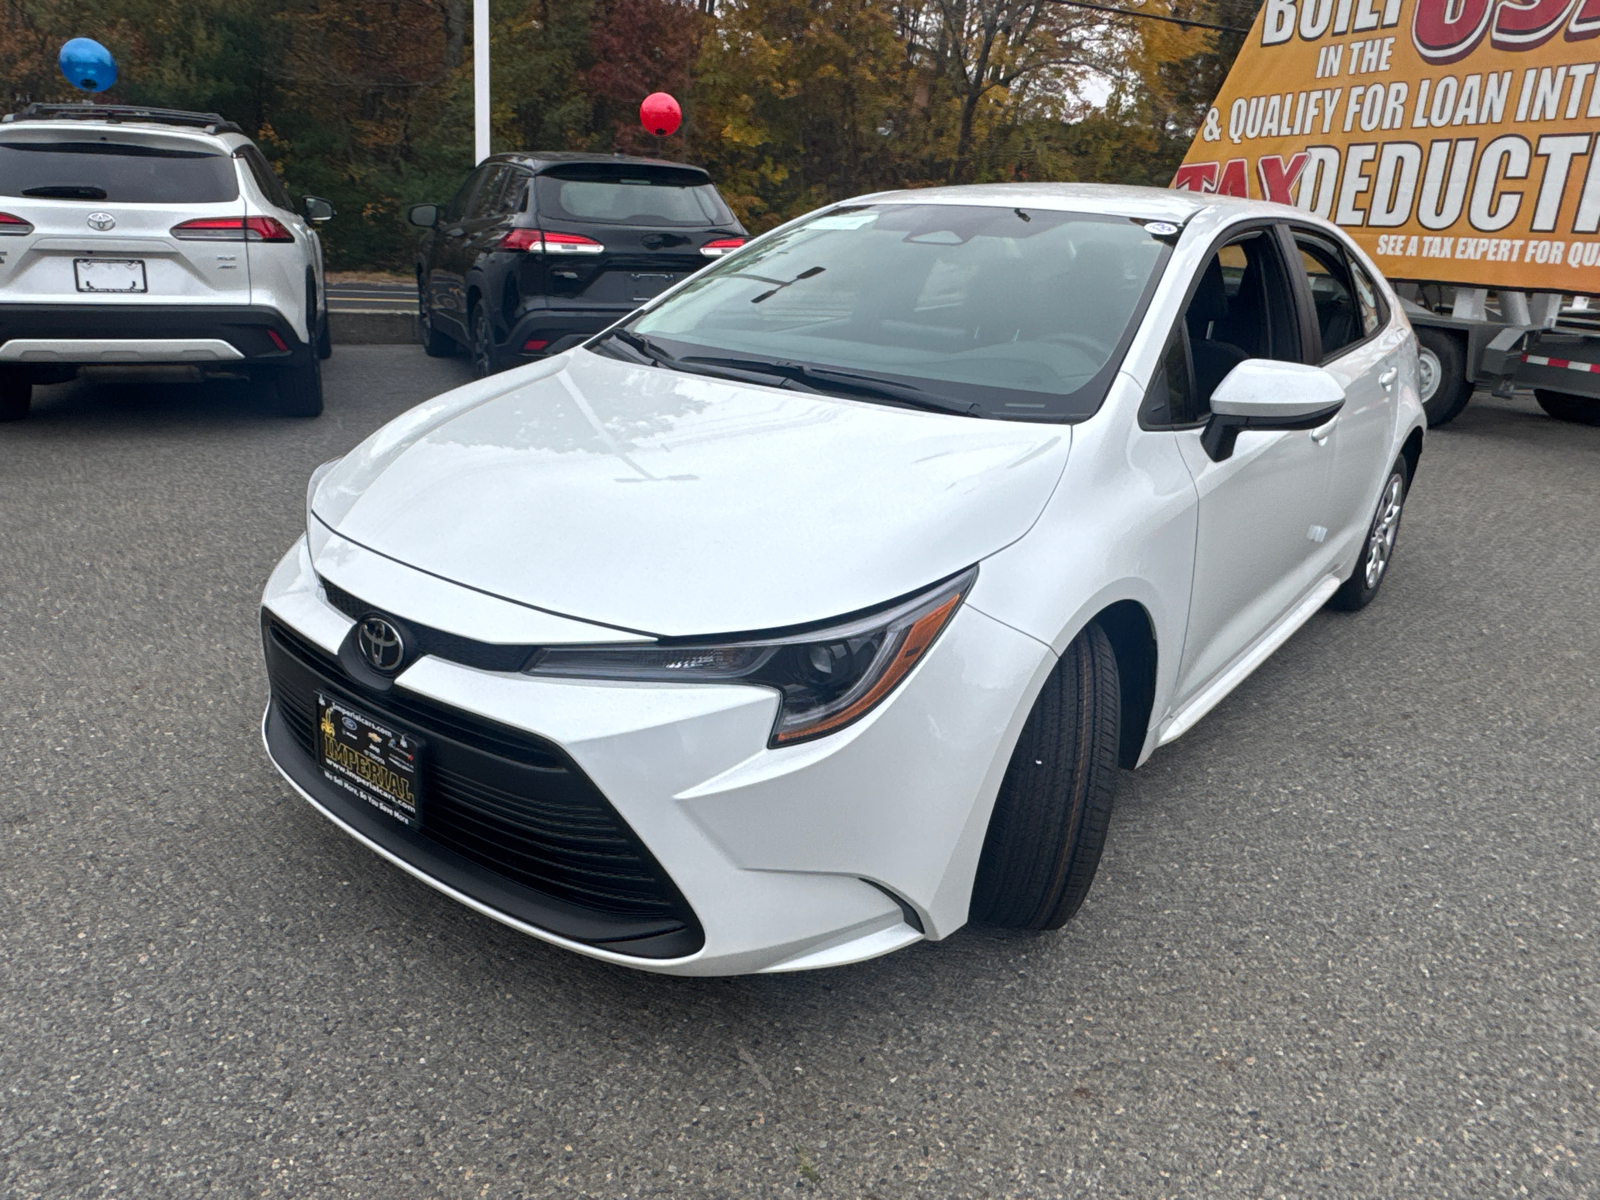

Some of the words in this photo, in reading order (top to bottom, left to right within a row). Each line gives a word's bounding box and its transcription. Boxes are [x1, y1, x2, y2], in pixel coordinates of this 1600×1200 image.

[1315, 44, 1343, 79] IN
[1348, 36, 1395, 75] THE
[1203, 108, 1222, 142] &
[1228, 88, 1342, 144] QUALIFY
[1343, 82, 1409, 133] FOR
[1411, 71, 1513, 128] LOAN
[1176, 152, 1311, 206] TAX
[1376, 234, 1406, 256] SEE
[1405, 235, 1419, 256] A
[1421, 236, 1454, 258] TAX
[1454, 237, 1525, 262] EXPERT
[1523, 240, 1566, 264] FOR
[324, 734, 415, 806] IMPERIAL
[325, 758, 416, 813] www.imperialcars.com
